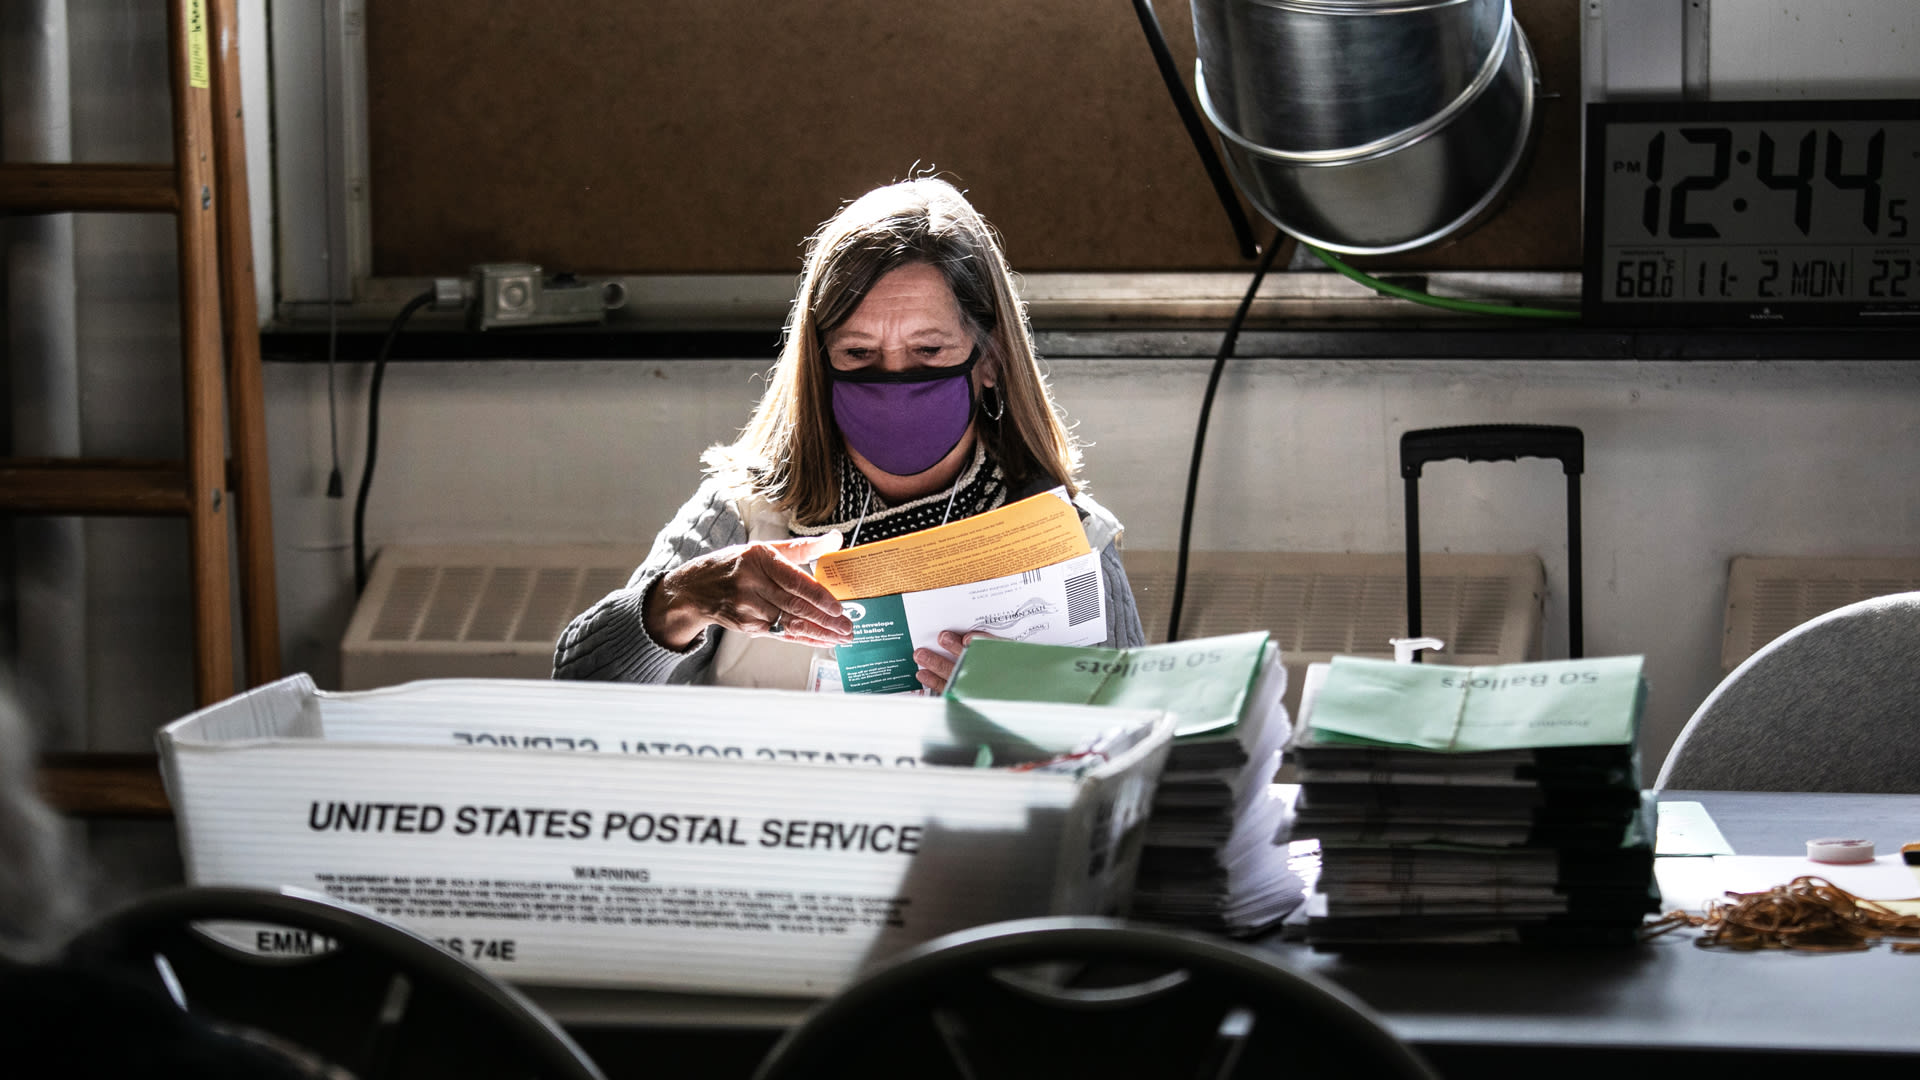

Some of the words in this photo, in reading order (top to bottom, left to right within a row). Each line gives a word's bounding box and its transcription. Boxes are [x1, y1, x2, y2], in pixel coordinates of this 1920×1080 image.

[1613, 161, 1641, 173] PM
[1643, 127, 1885, 238] 12:44
[1791, 261, 1846, 297] MON
[1074, 656, 1177, 679] Ballots
[1186, 649, 1222, 668] 50
[1441, 676, 1547, 690] Ballots
[1559, 672, 1599, 686] 50
[309, 802, 445, 834] UNITED
[454, 805, 592, 839] STATES
[602, 811, 747, 845] POSTAL
[759, 818, 924, 855] SERVICE
[573, 866, 650, 883] WARNING
[257, 931, 313, 954] EMM
[472, 938, 516, 961] 74E
